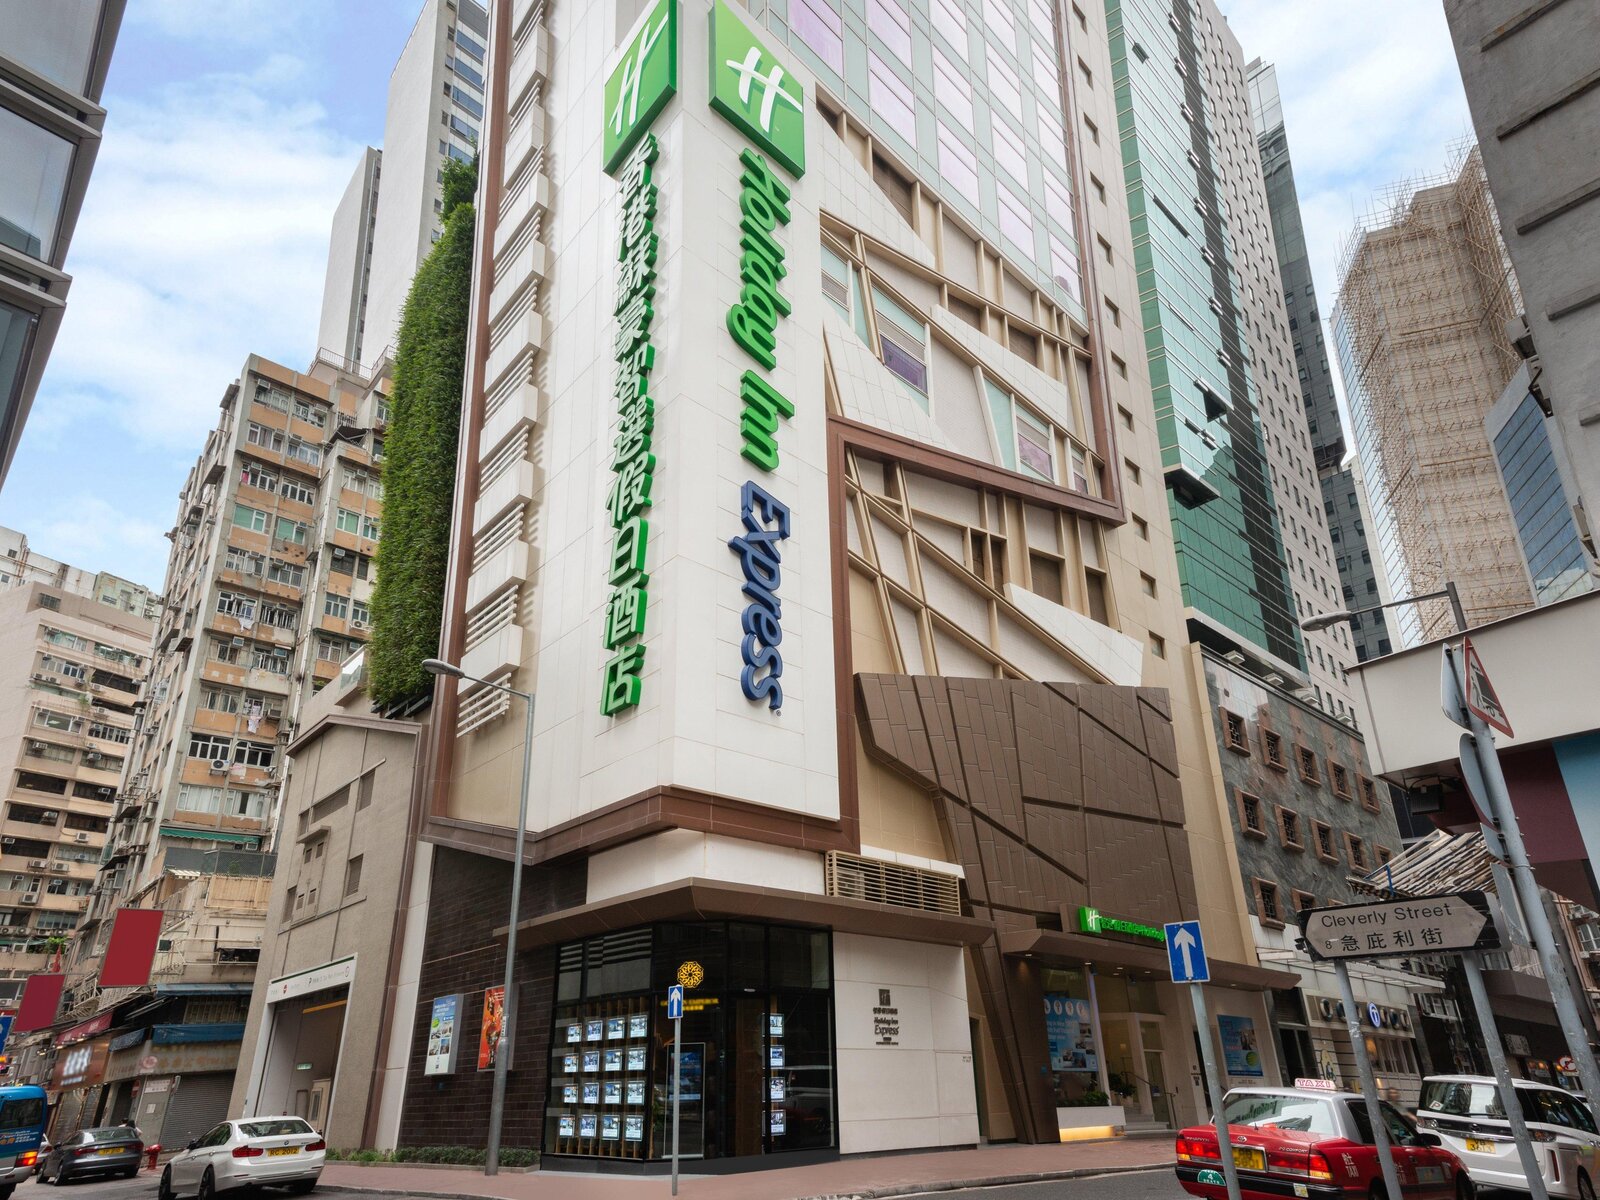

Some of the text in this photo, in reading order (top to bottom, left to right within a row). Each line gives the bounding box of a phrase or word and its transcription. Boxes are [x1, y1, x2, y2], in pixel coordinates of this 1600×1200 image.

[726, 147, 795, 711] Holiday Inn Express
[1321, 902, 1452, 928] Cleverly Street
[1340, 927, 1444, 952] 急庇利街
[874, 1025, 899, 1037] Express
[1297, 1079, 1331, 1088] TAXI
[281, 1147, 299, 1155] 2012
[1345, 1165, 1360, 1178] TAXI
